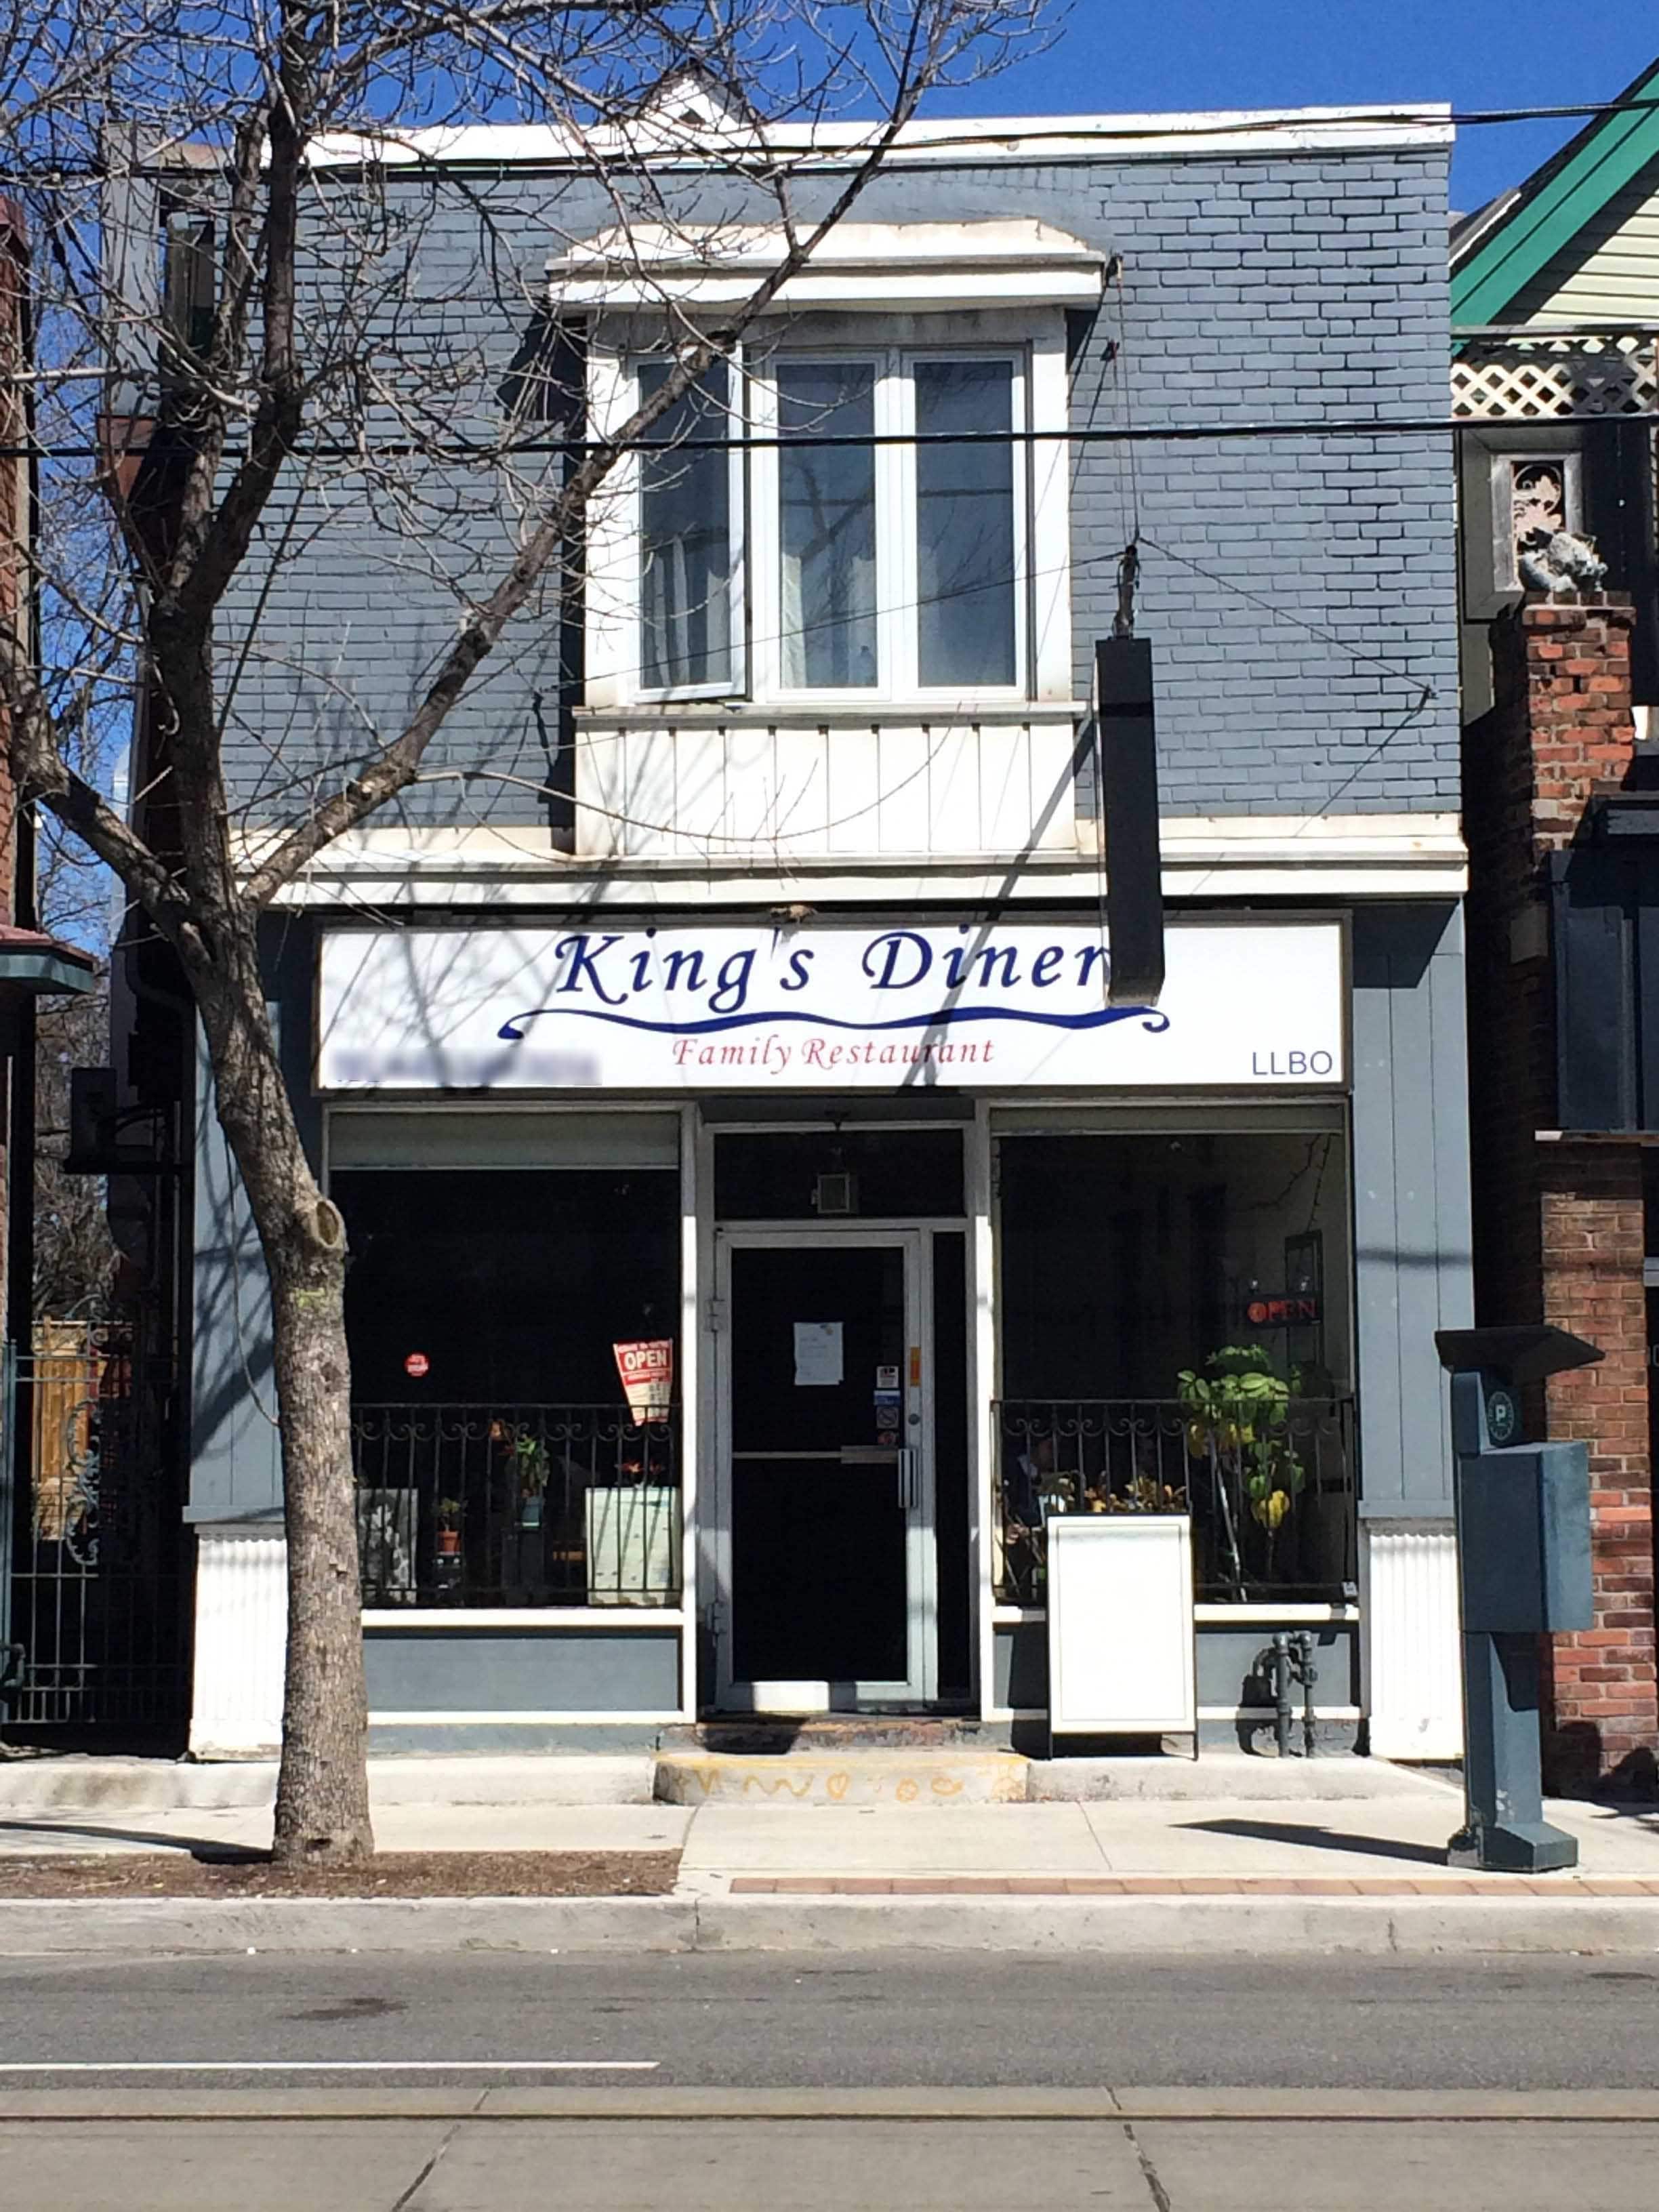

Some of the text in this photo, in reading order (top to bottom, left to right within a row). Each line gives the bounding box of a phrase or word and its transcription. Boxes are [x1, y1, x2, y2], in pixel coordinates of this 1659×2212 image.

[555, 926, 815, 1014] King's
[672, 1034, 996, 1073] Family Restaurant
[1251, 1050, 1333, 1076] LLBO
[623, 1349, 668, 1370] OPEN
[1495, 1404, 1507, 1422] P
